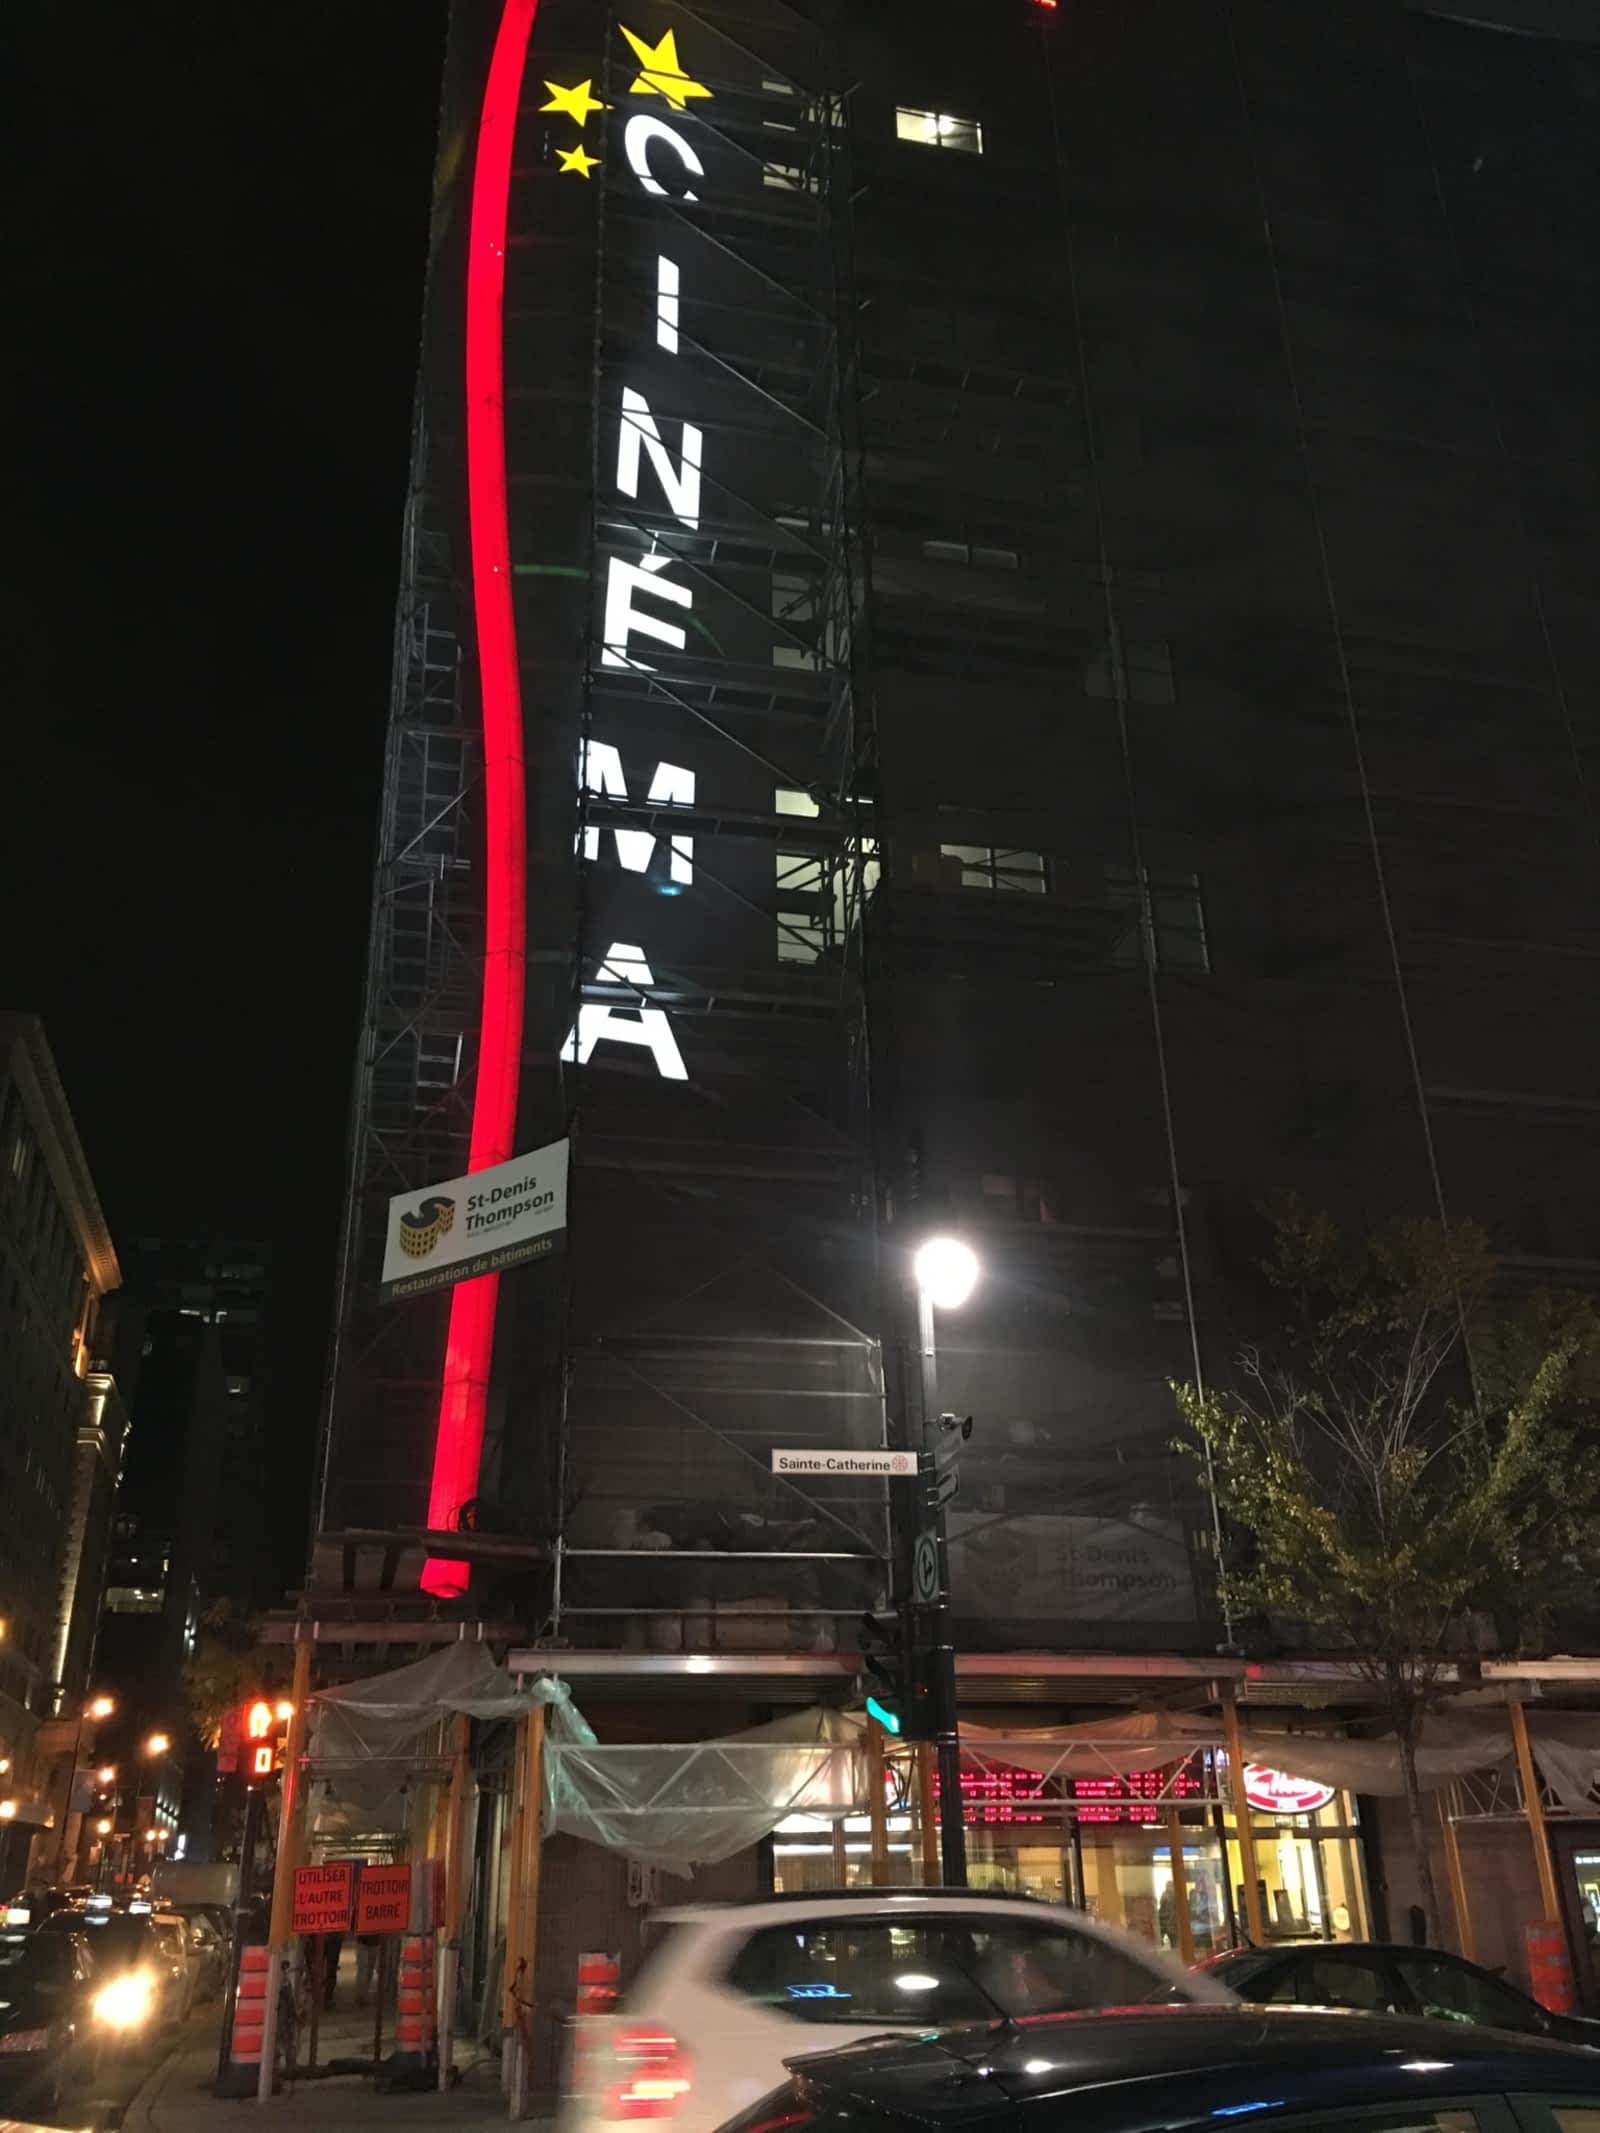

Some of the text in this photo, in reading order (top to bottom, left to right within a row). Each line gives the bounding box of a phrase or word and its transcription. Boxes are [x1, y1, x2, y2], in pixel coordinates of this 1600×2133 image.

[559, 114, 705, 1082] CINÉMA
[467, 1175, 537, 1212] St-Denis
[465, 1190, 555, 1231] Thompson
[392, 1237, 553, 1297] Restauration de bâtiments
[778, 1456, 891, 1472] Sainte-Catherine
[298, 1870, 346, 1885] UTILISER
[362, 1879, 409, 1896] TROTTOIR
[299, 1889, 344, 1905] L'AUTRE
[295, 1910, 347, 1927] TROTTOIR
